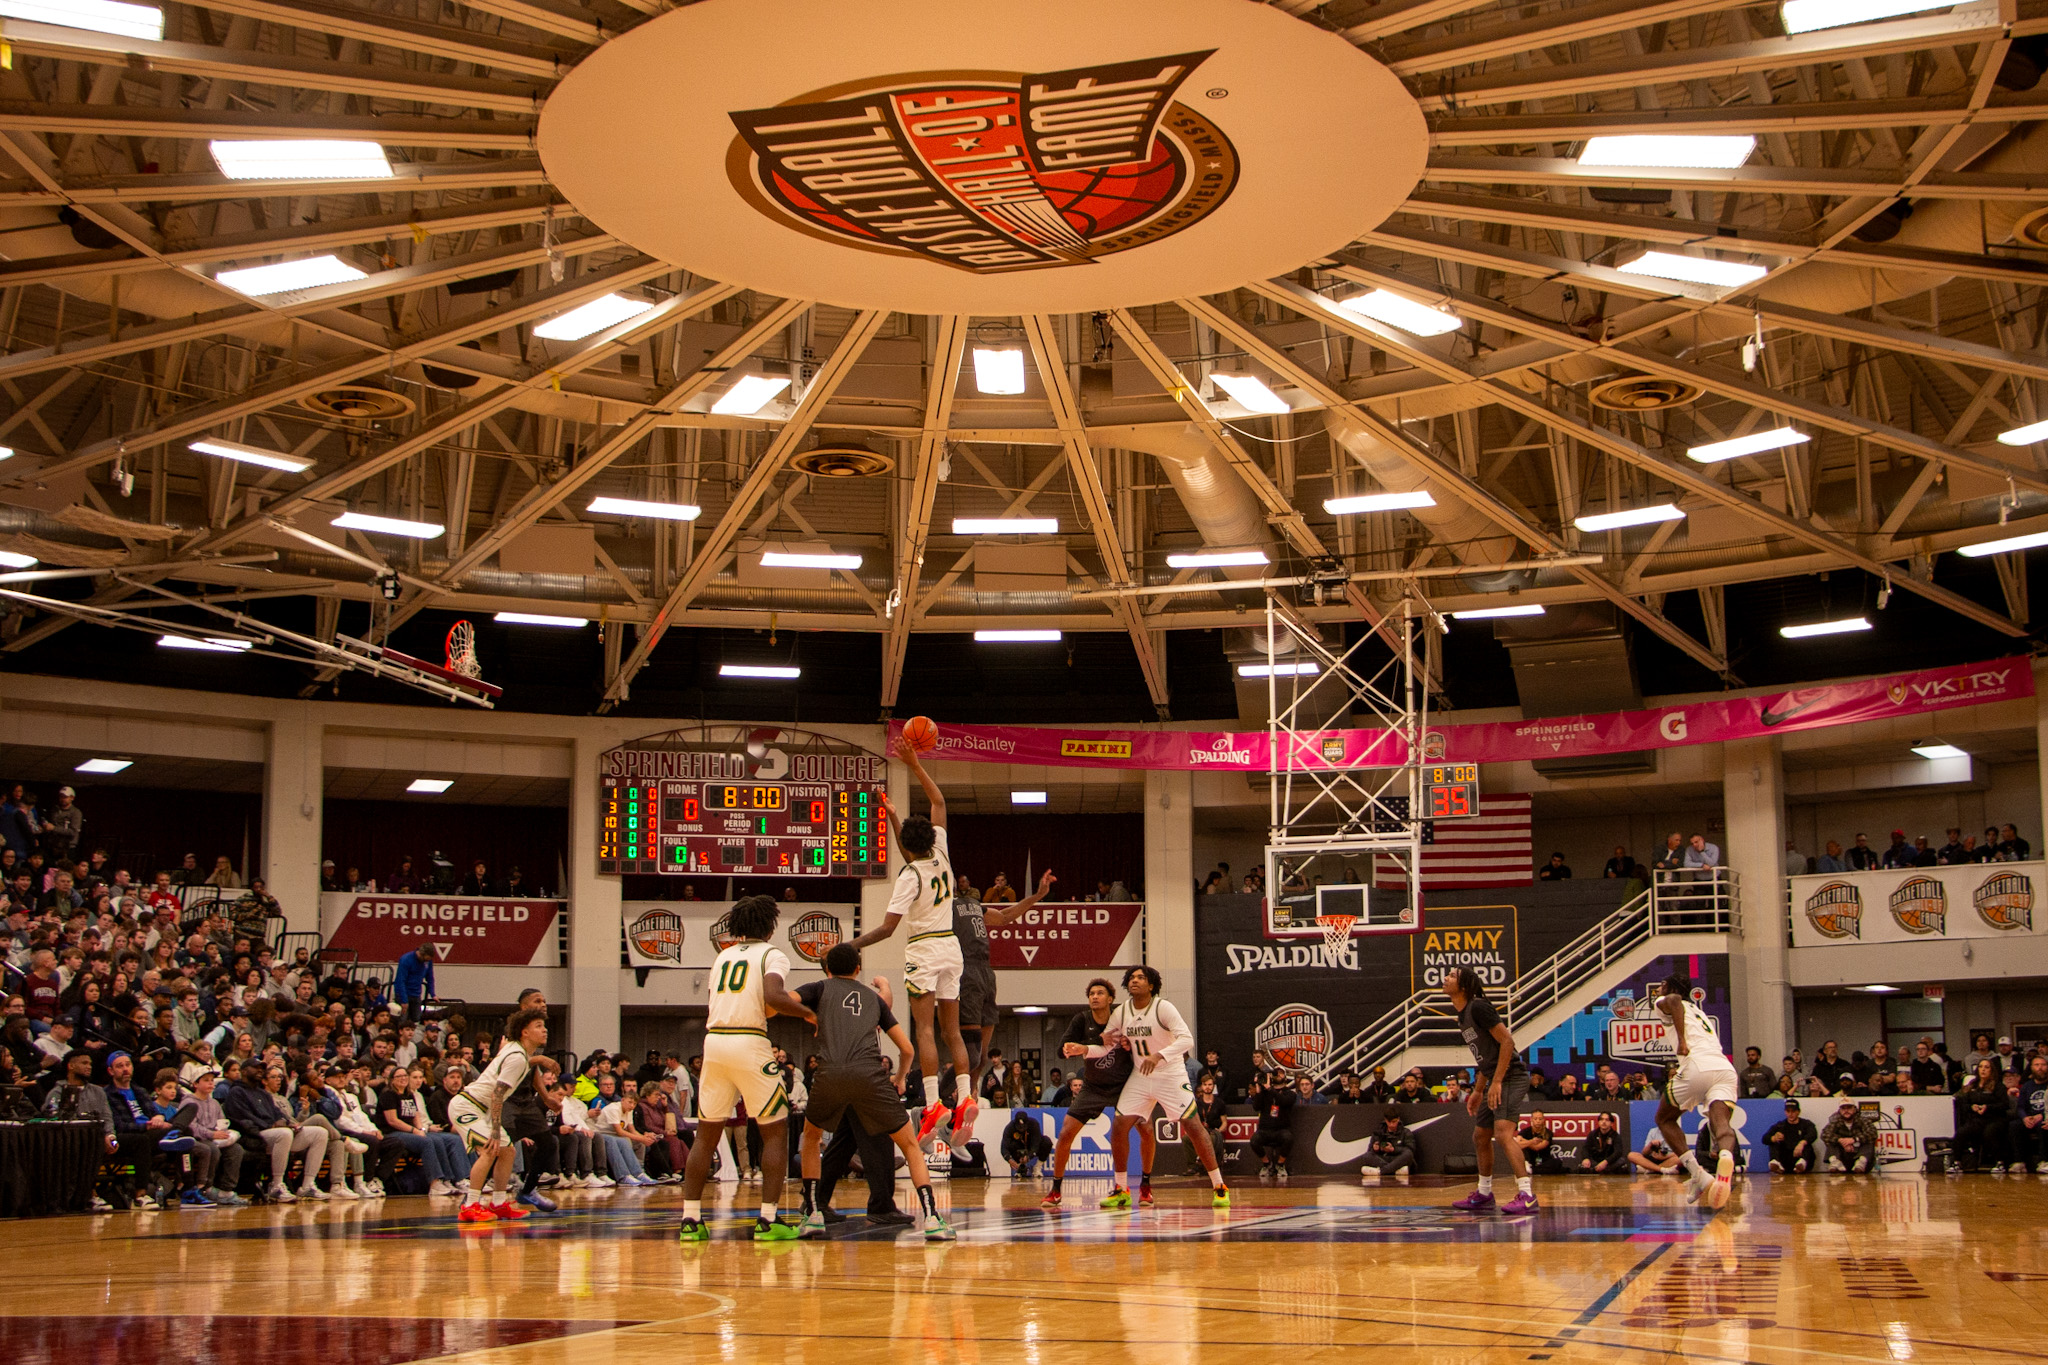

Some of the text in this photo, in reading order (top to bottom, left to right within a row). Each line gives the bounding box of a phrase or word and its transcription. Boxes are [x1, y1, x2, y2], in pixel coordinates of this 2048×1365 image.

[1030, 65, 1184, 167] FAME
[902, 96, 1046, 206] HALL OF
[753, 106, 1040, 265] BASKETBALL
[1101, 112, 1224, 249] SPRINGFIELD MASS.
[1911, 668, 2011, 698] VKTRY
[1515, 722, 1596, 736] SPRINGFIELD
[1536, 733, 1576, 741] COLLEGE
[935, 735, 1016, 755] gan Stanley
[1066, 743, 1127, 754] PANINI
[1189, 749, 1250, 764] SPALDING
[610, 751, 879, 781] SPRINGFIELD COLLEGE
[641, 779, 656, 787] PTS
[667, 784, 697, 794] HOME
[613, 787, 657, 800] 1 0 0
[724, 786, 780, 808] 8:00
[788, 787, 828, 797] VISITOR
[840, 792, 847, 803] 0
[609, 802, 657, 815] 3 0 0
[1432, 786, 1468, 816] 35
[684, 799, 698, 820] 0
[810, 801, 824, 823] 0
[840, 807, 886, 819] 4 0 0
[605, 816, 657, 830] 10 0 0
[677, 824, 703, 832] BONUS
[761, 817, 766, 833] 1
[787, 826, 812, 834] BONUS
[836, 821, 886, 834] 13 0 0
[605, 831, 656, 844] 11 0 0
[664, 837, 687, 845] FOULS
[832, 835, 847, 847] 22
[878, 835, 886, 848] 0
[601, 845, 656, 859] 21 0 0
[675, 846, 687, 863] 0
[814, 848, 825, 865] 0
[832, 849, 847, 861] 25
[878, 849, 886, 862] 0
[931, 871, 950, 907] 21
[357, 902, 529, 922] SPRINGFIELD
[400, 925, 486, 937] COLLEGE
[632, 916, 679, 934] BASKETBALL
[791, 918, 837, 937] BASKETBALL
[971, 917, 988, 938] 13
[809, 932, 823, 943] HALL
[989, 929, 1069, 939] COLLEGE
[1424, 931, 1503, 951] ARMY
[659, 942, 680, 960] FAME
[1226, 938, 1357, 975] SPALDING
[1424, 951, 1504, 966] NATIONAL
[717, 960, 749, 994] 10
[1925, 986, 1941, 996] EXIT
[843, 991, 862, 1016] 4
[1126, 1026, 1152, 1036] GRAYSON
[1262, 1015, 1322, 1041] BASKETBALL
[1135, 1039, 1151, 1056] 11
[1286, 1036, 1324, 1052] HALL OF
[1644, 1040, 1673, 1054] Class
[1223, 1149, 1240, 1161] eal
[1550, 1144, 1577, 1159] Real
[1837, 1257, 1930, 1299] COLLEGE
[1620, 1245, 1782, 1329] SPRINGFIELD
